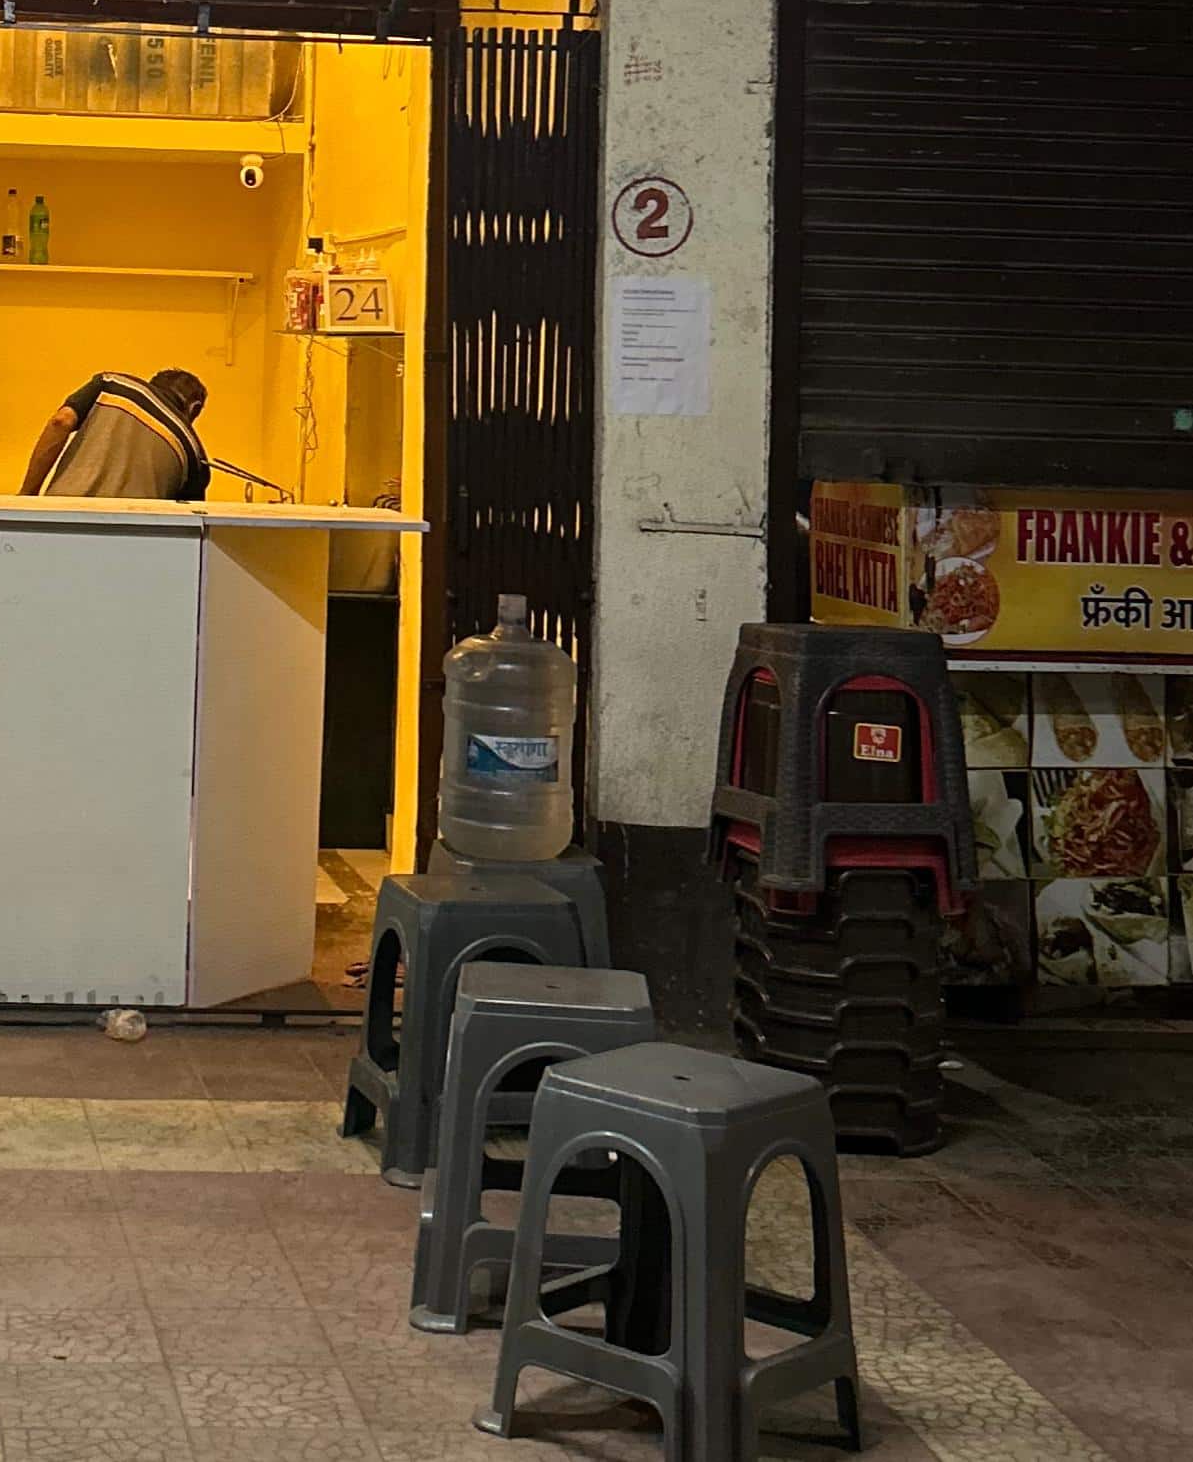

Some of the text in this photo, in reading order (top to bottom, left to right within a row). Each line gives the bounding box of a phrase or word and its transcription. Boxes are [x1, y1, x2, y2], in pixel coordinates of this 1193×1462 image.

[631, 187, 670, 240] 2
[335, 287, 384, 321] 24
[1017, 509, 1193, 566] FRANKIE &
[815, 539, 898, 613] BHEL KATTA
